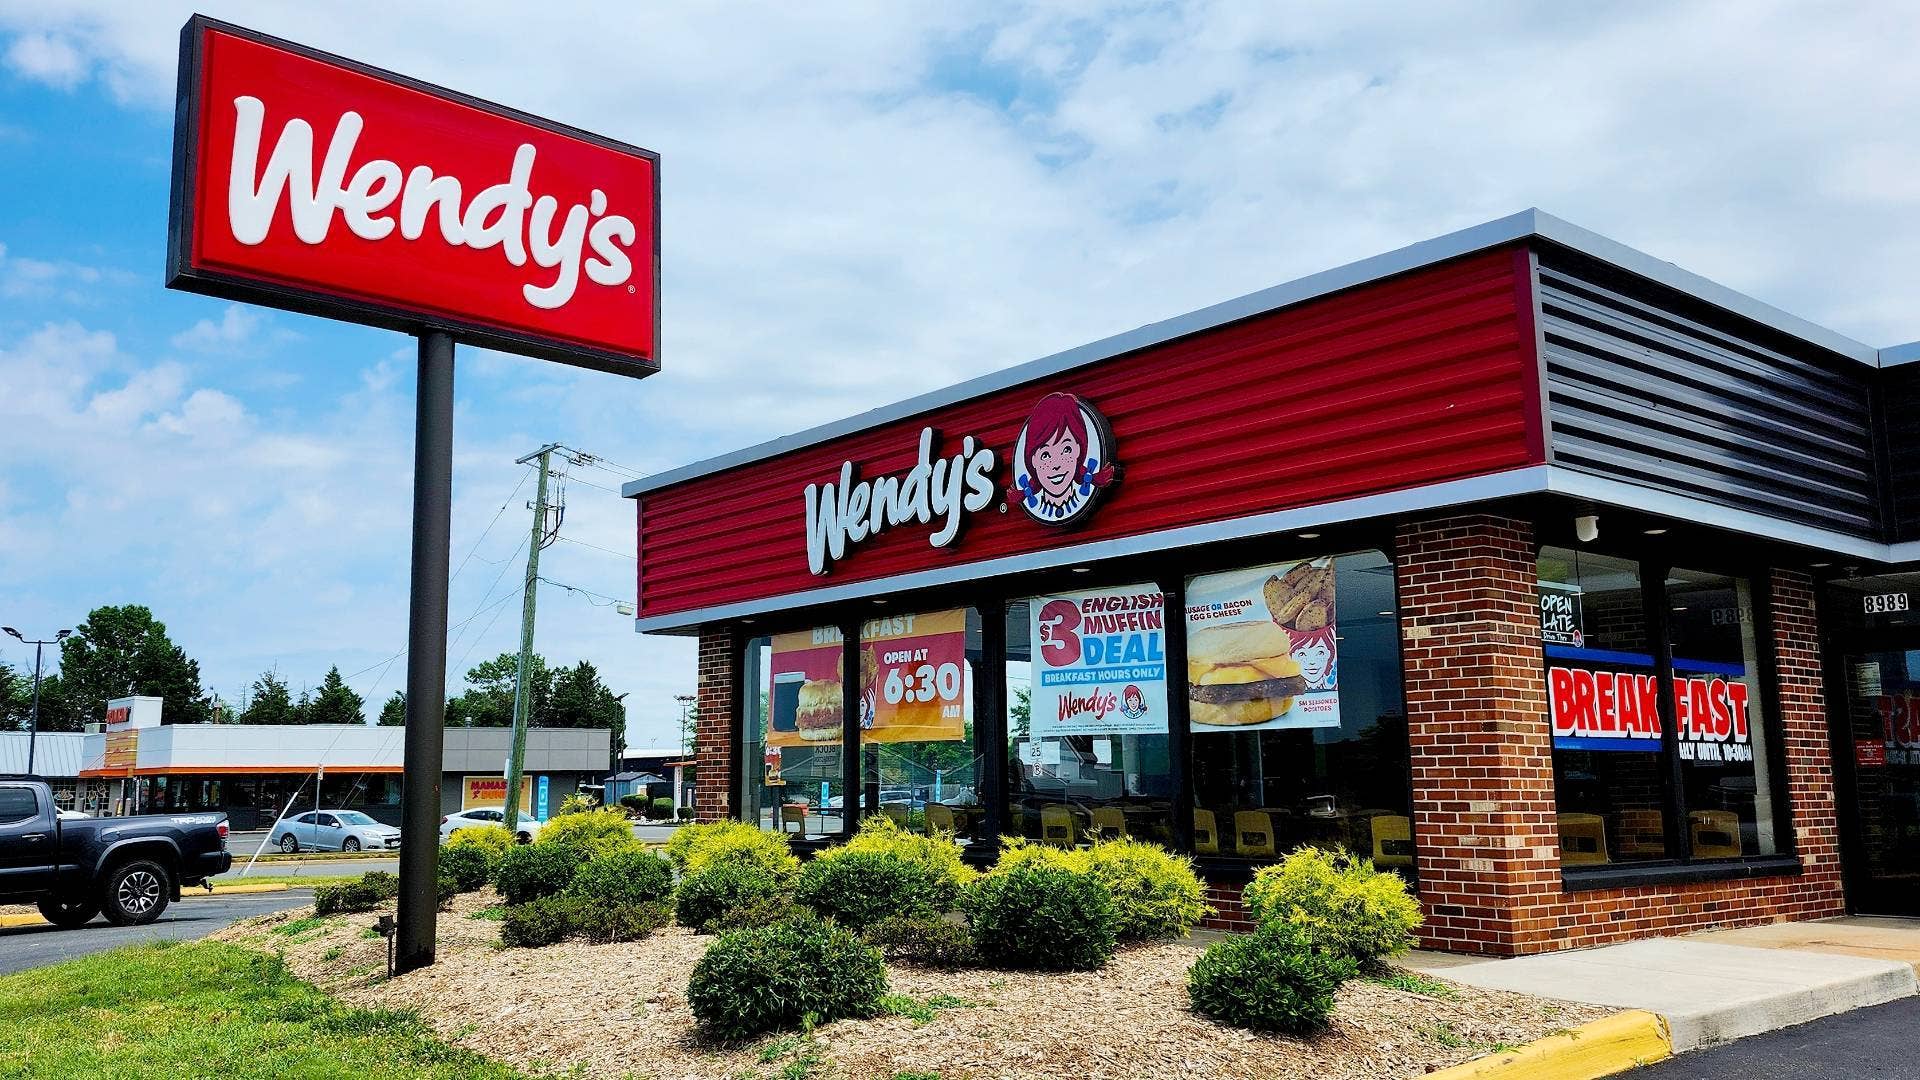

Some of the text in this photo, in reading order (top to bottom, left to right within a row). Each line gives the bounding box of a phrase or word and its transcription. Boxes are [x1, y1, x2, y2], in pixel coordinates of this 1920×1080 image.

[229, 95, 636, 309] Wendy's
[804, 427, 995, 576] Wendy's
[1082, 593, 1163, 614] ENGLISH
[1185, 604, 1210, 614] USAGE
[1223, 599, 1252, 610] BACON
[1541, 595, 1572, 615] OPEN
[1865, 593, 1907, 613] 8989
[1083, 610, 1163, 635] MUFFIN
[1190, 613, 1205, 621] EGG
[1213, 608, 1242, 618] CHEESE
[1543, 611, 1575, 632] LATE
[812, 614, 914, 645] BREKFAST
[1039, 599, 1081, 667] $3
[884, 648, 928, 664] OPEN AT
[1082, 632, 1164, 666] DEAL
[883, 662, 961, 704] 6:30
[1045, 667, 1160, 684] BREAKFAST HOURS ONLY
[942, 704, 961, 719] AM
[1058, 686, 1118, 721] Wendy's
[1697, 742, 1722, 761] UNTIL
